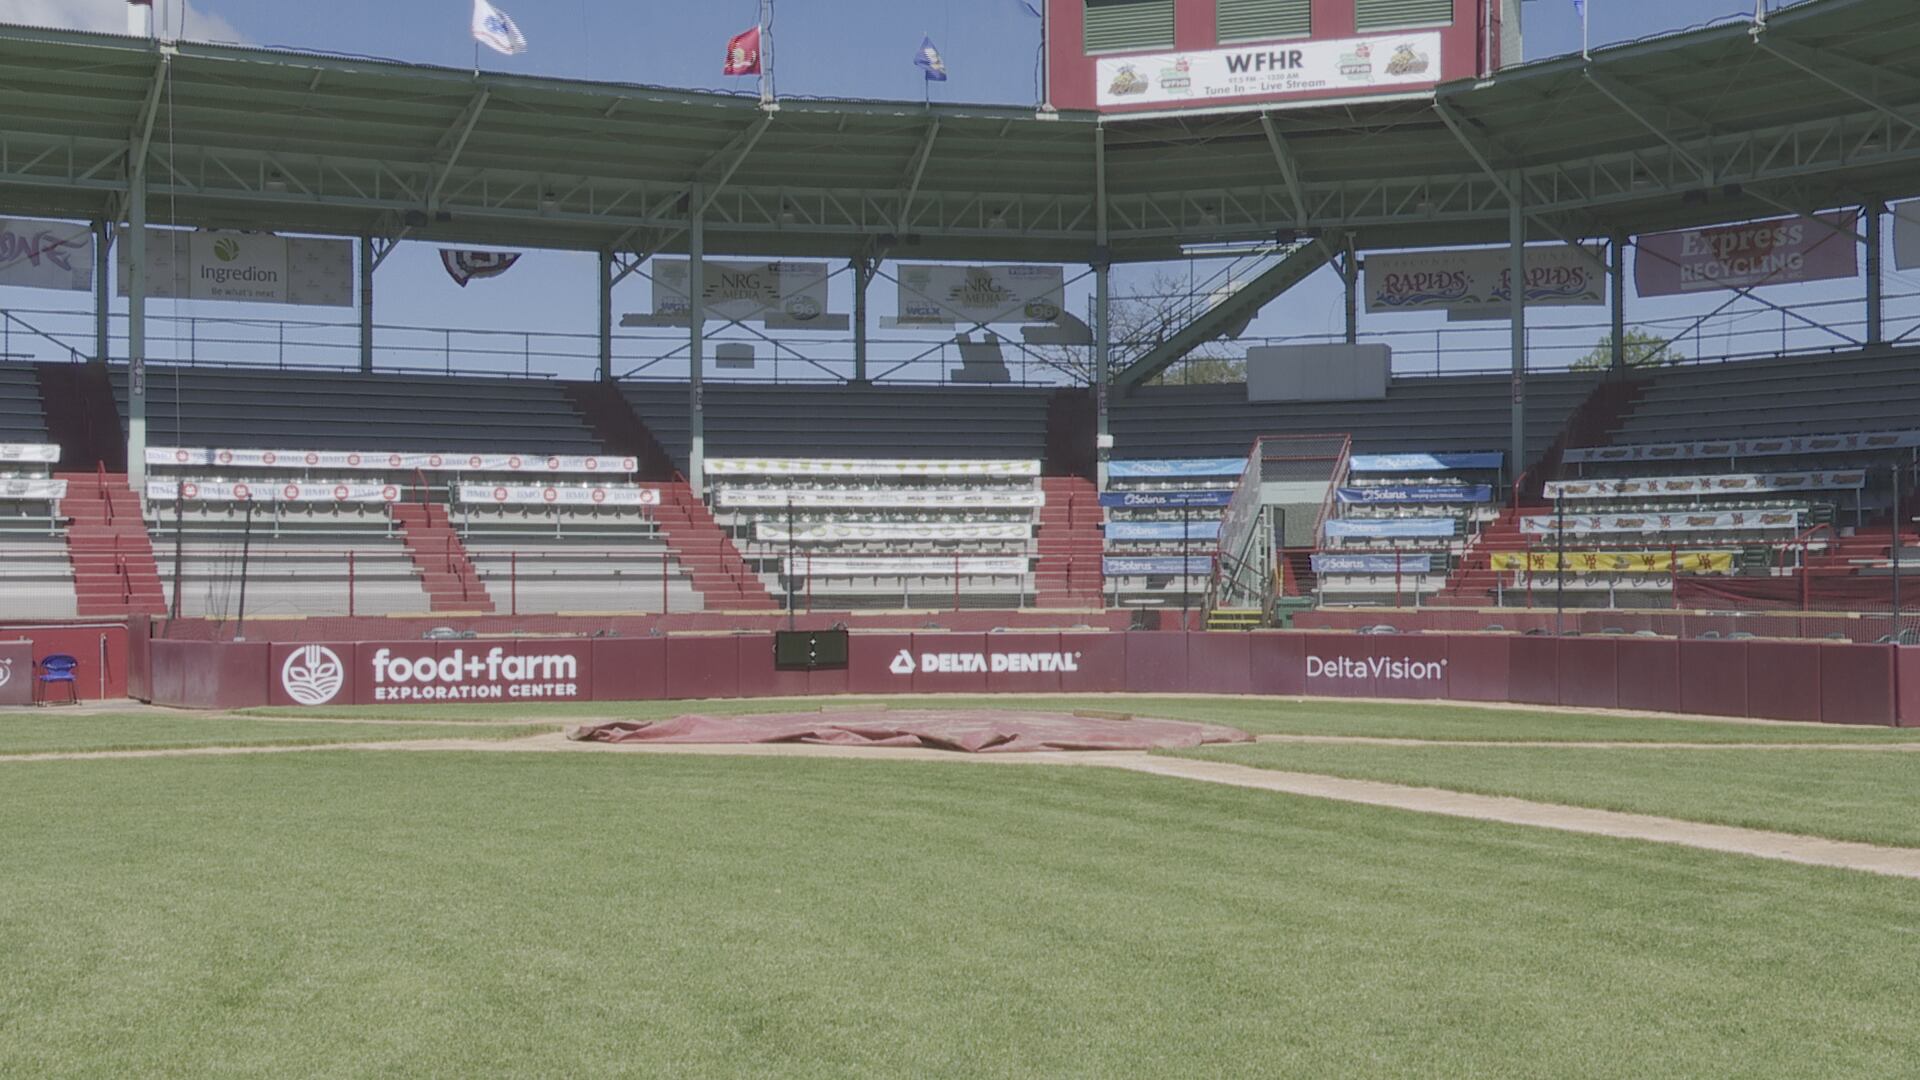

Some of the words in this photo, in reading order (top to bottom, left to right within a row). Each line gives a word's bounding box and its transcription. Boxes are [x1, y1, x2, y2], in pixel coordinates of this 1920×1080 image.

[1226, 50, 1305, 74] WFHR
[1342, 65, 1370, 74] WFHR
[1162, 79, 1190, 88] WFHR
[1286, 72, 1299, 80] AM
[1204, 84, 1230, 96] Tune
[1234, 84, 1245, 93] In
[1261, 81, 1283, 91] Live
[1286, 79, 1326, 90] Stream
[1680, 223, 1804, 259] Express
[200, 264, 278, 284] Ingredion
[1680, 253, 1804, 281] RECYCLING
[721, 272, 760, 289] NRG
[964, 277, 1002, 293] NRG
[1384, 270, 1466, 294] RAPIDS
[1499, 266, 1584, 290] RAPIDS
[211, 287, 222, 297] Be
[256, 288, 275, 298] next
[721, 289, 760, 300] MEDIA
[966, 293, 1000, 303] MEDIA
[1135, 493, 1167, 504] Solarus
[1374, 489, 1408, 500] Solarus
[1119, 561, 1153, 571] Solarus
[1330, 559, 1364, 569] Solarus
[372, 647, 578, 683] food+farm
[922, 652, 988, 673] DELTA
[1306, 655, 1442, 681] DeltaVision
[374, 684, 502, 700] EXPLORATION
[508, 683, 577, 697] CENTER
